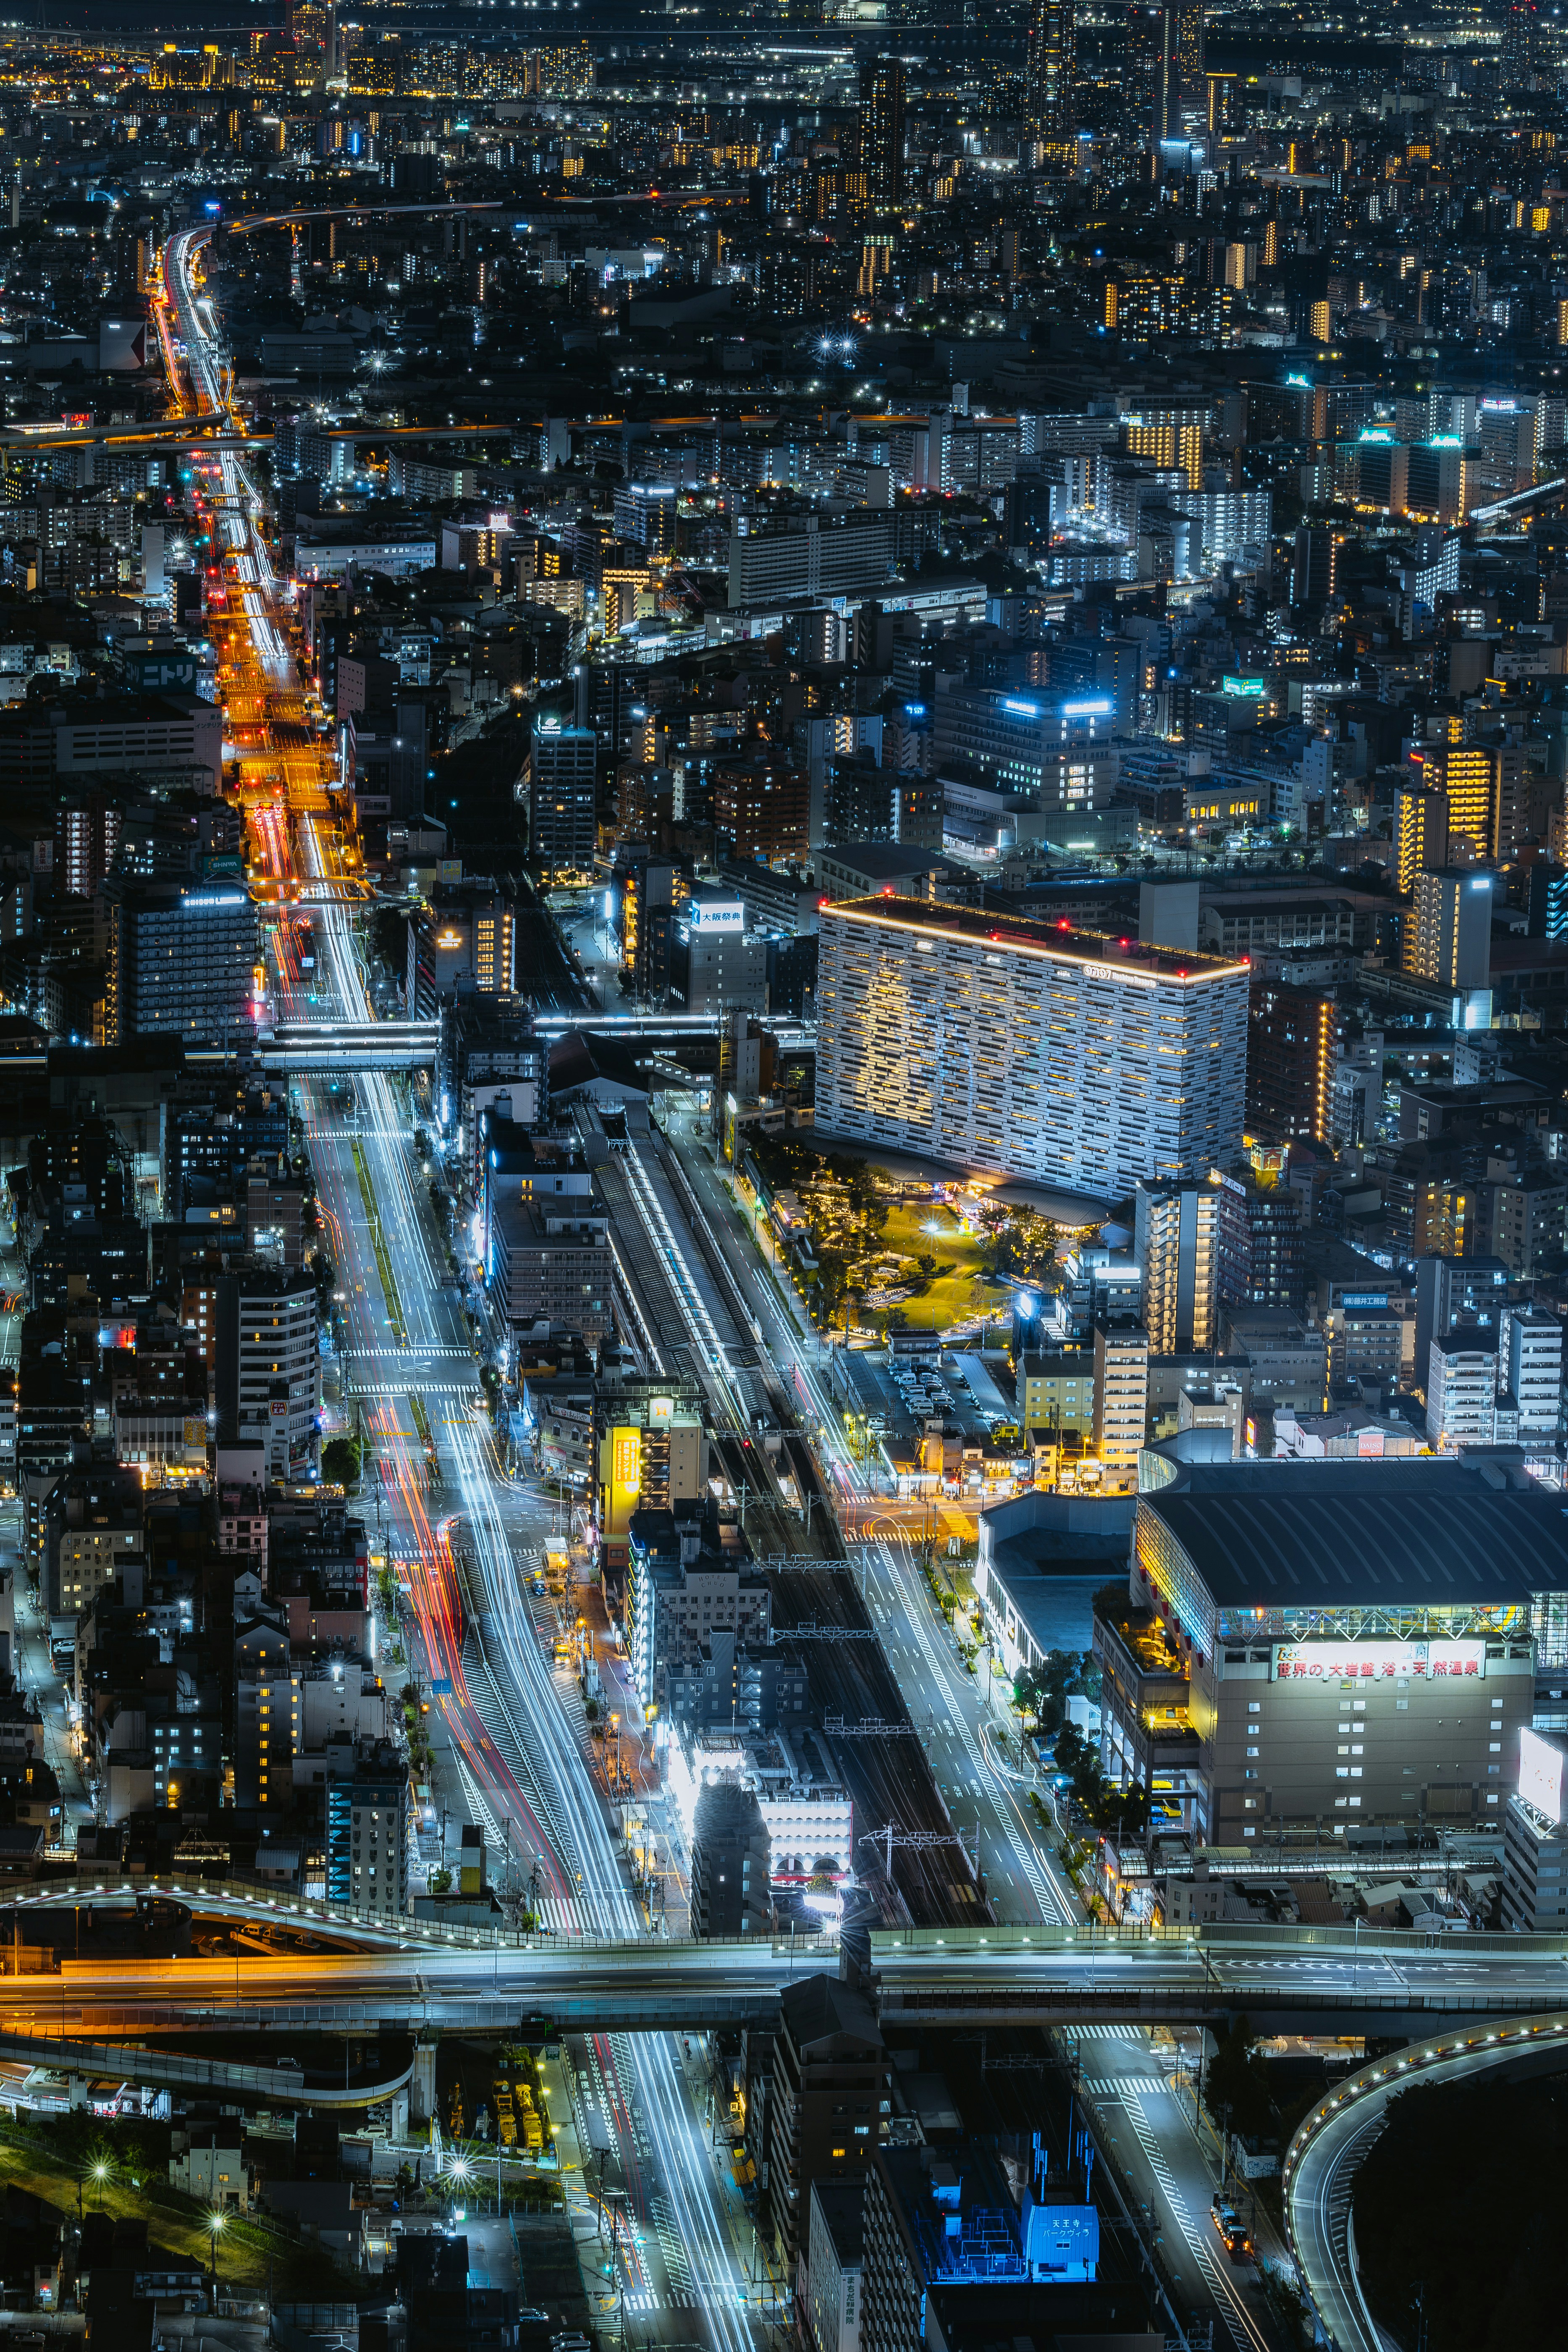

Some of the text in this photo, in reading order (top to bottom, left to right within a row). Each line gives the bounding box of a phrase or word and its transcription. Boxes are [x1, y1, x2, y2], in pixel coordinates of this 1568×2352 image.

[144, 664, 192, 686] ニトリ
[702, 912, 740, 922] 大阪祭典
[1343, 1297, 1387, 1306] (株)藤井工務店
[480, 1738, 492, 1750] 40
[952, 1785, 964, 1798] 左折
[969, 1779, 983, 1798] 直右折
[577, 2070, 595, 2111] 速度落せ
[603, 2070, 621, 2111] 速度落せ
[1052, 2219, 1080, 2228] 天王寺
[1043, 2229, 1090, 2238] パークヴィラ
